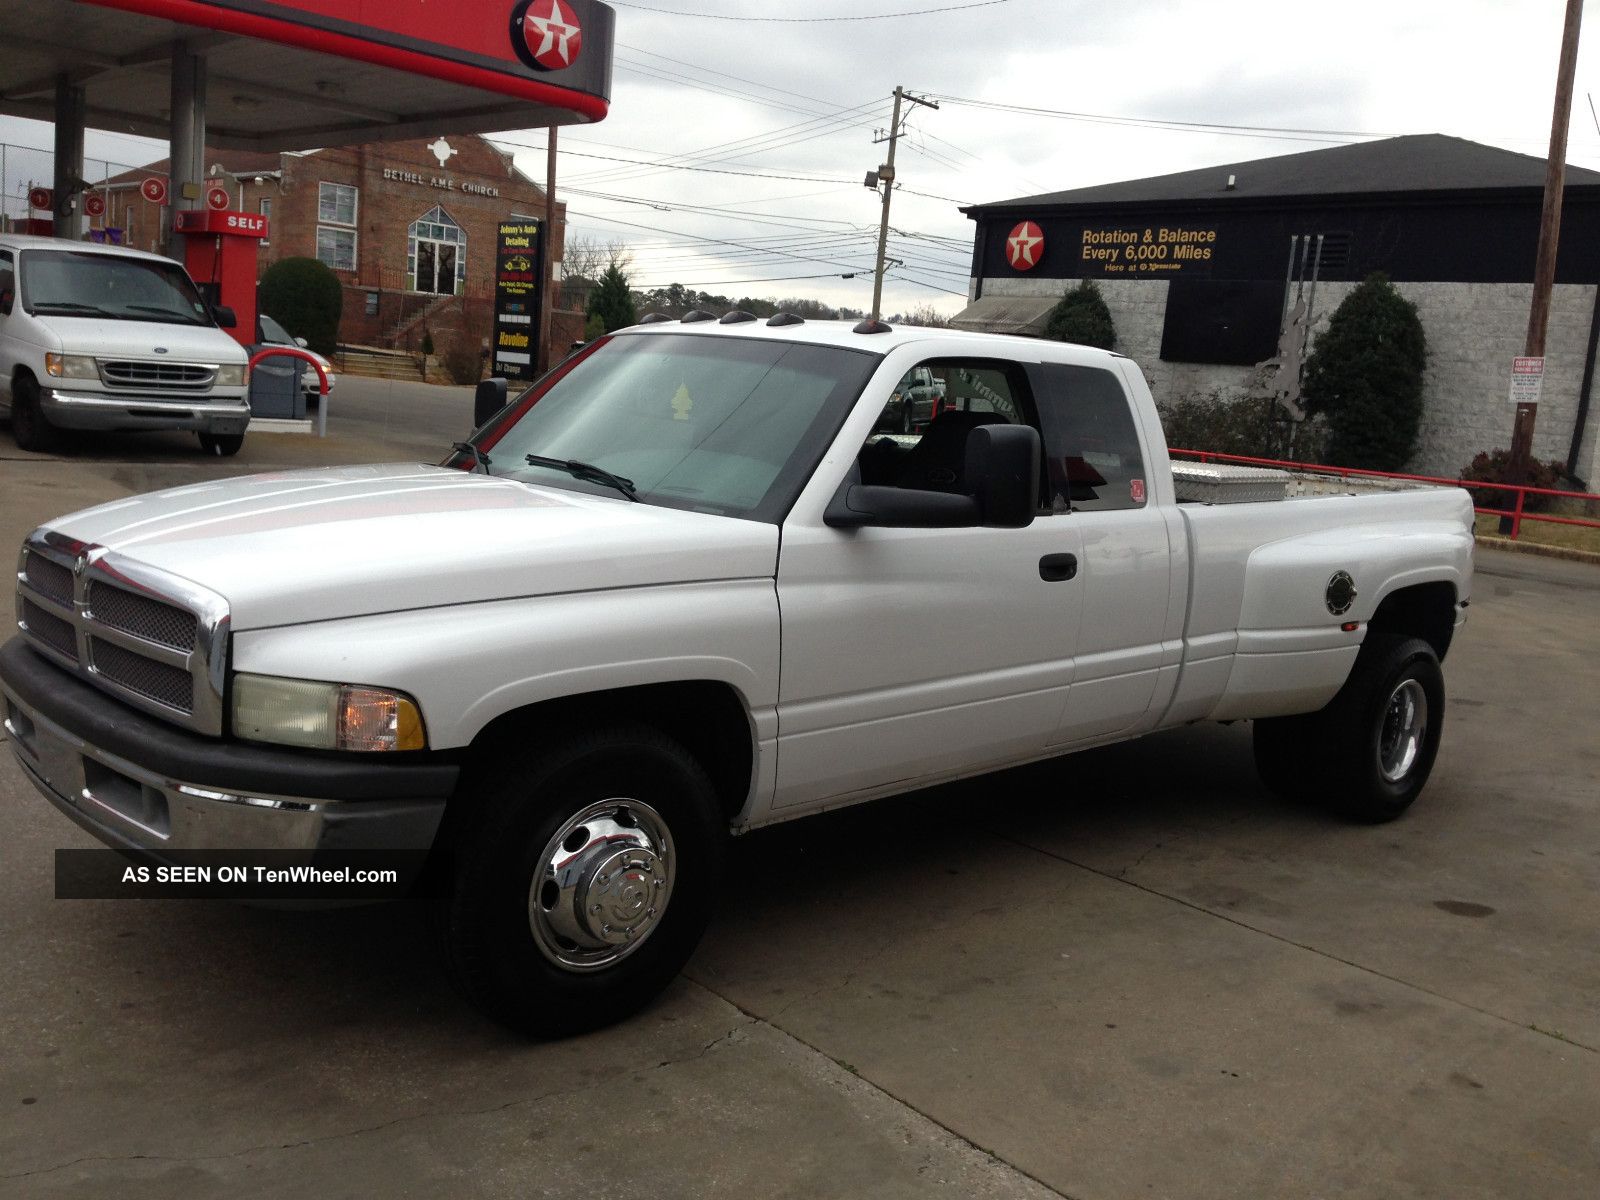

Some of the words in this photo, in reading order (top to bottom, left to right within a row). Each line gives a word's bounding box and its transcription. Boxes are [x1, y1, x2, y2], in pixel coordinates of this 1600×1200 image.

[151, 184, 158, 194] 3
[384, 168, 424, 185] BETHEL
[462, 182, 499, 197] CHURCH
[214, 194, 222, 204] 4
[227, 215, 264, 231] SELF
[524, 225, 537, 234] Auto
[1082, 229, 1138, 244] Rotation
[1143, 228, 1153, 243] &
[1158, 227, 1216, 243] Balance
[1082, 245, 1120, 262] Every
[1125, 244, 1168, 261] 6,000
[1173, 244, 1212, 259] Miles
[1105, 263, 1125, 272] Here
[1128, 264, 1137, 272] at
